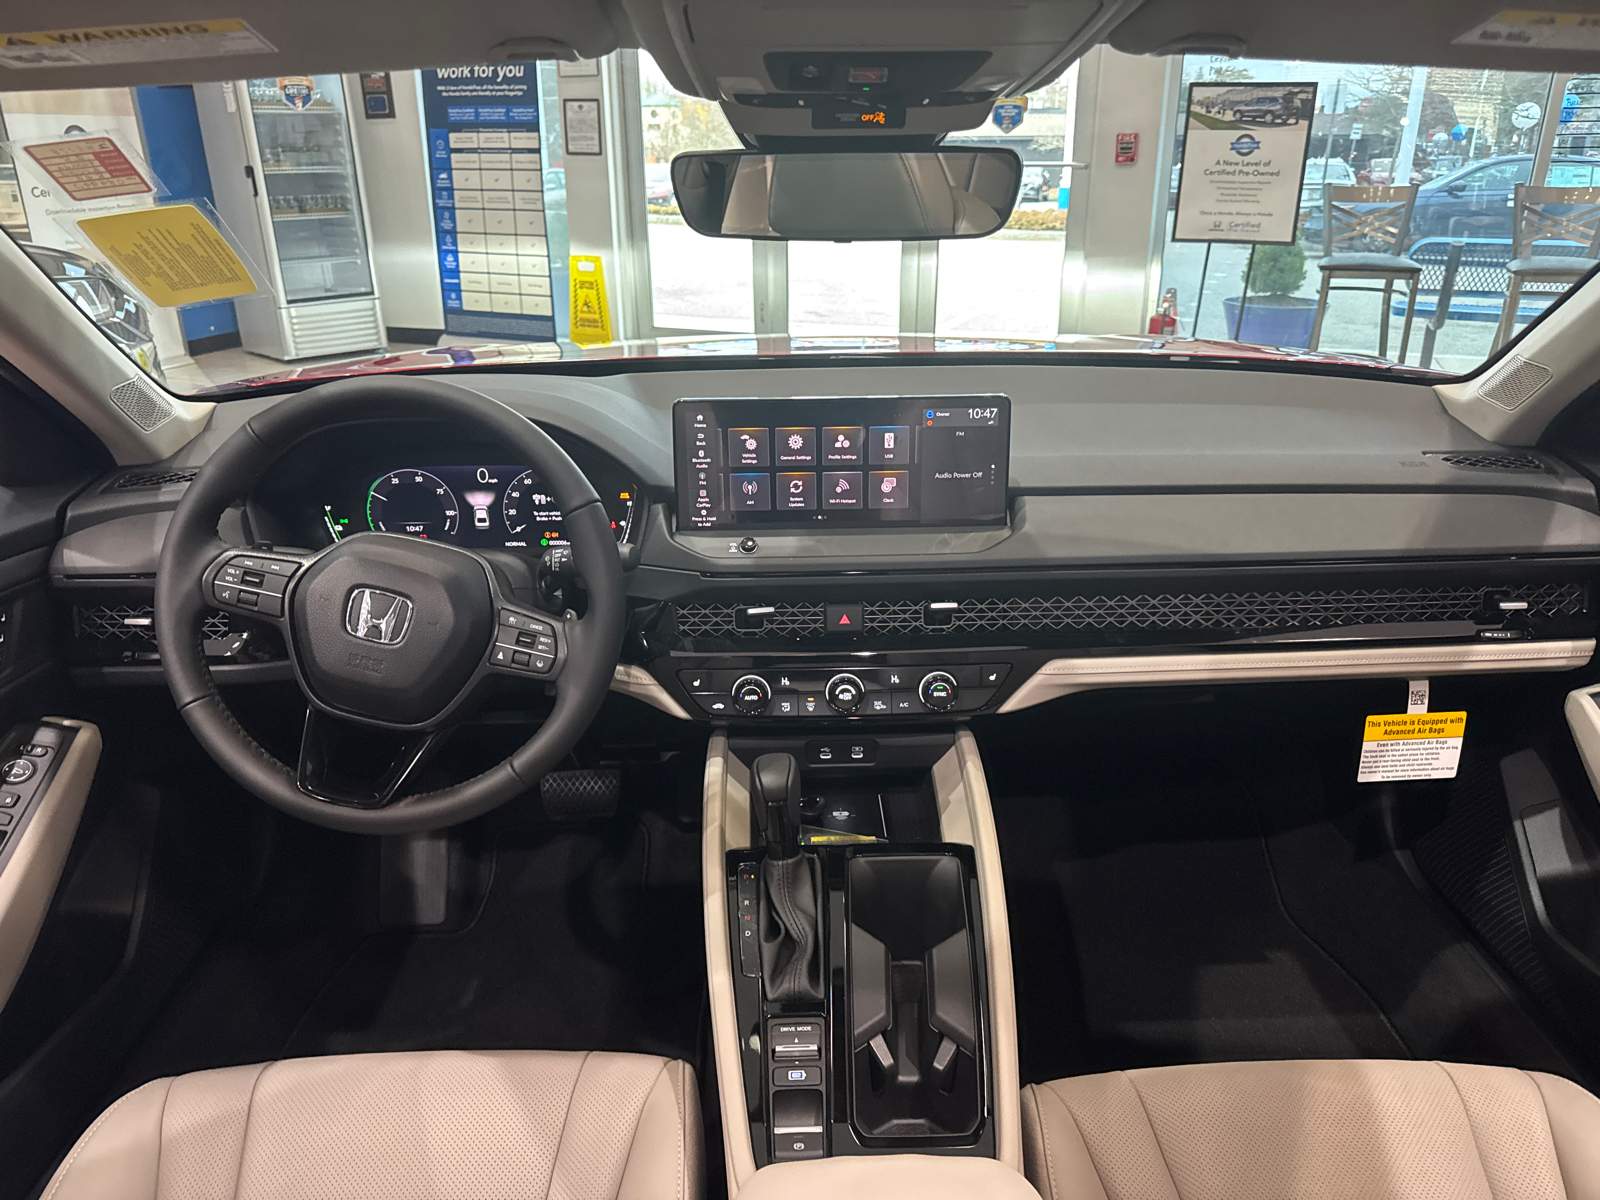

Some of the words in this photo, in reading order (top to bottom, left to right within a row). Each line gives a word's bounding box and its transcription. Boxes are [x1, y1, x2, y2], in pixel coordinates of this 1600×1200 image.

[45, 24, 209, 44] WARNING
[436, 66, 471, 79] work
[497, 65, 524, 82] you
[1204, 168, 1236, 176] Certified
[1238, 169, 1280, 177] Pre-Owned
[968, 408, 998, 419] 10:47
[477, 468, 489, 484] 0
[1417, 718, 1448, 727] Equipped
[1383, 728, 1416, 736] Advanced
[1428, 727, 1445, 735] Bags
